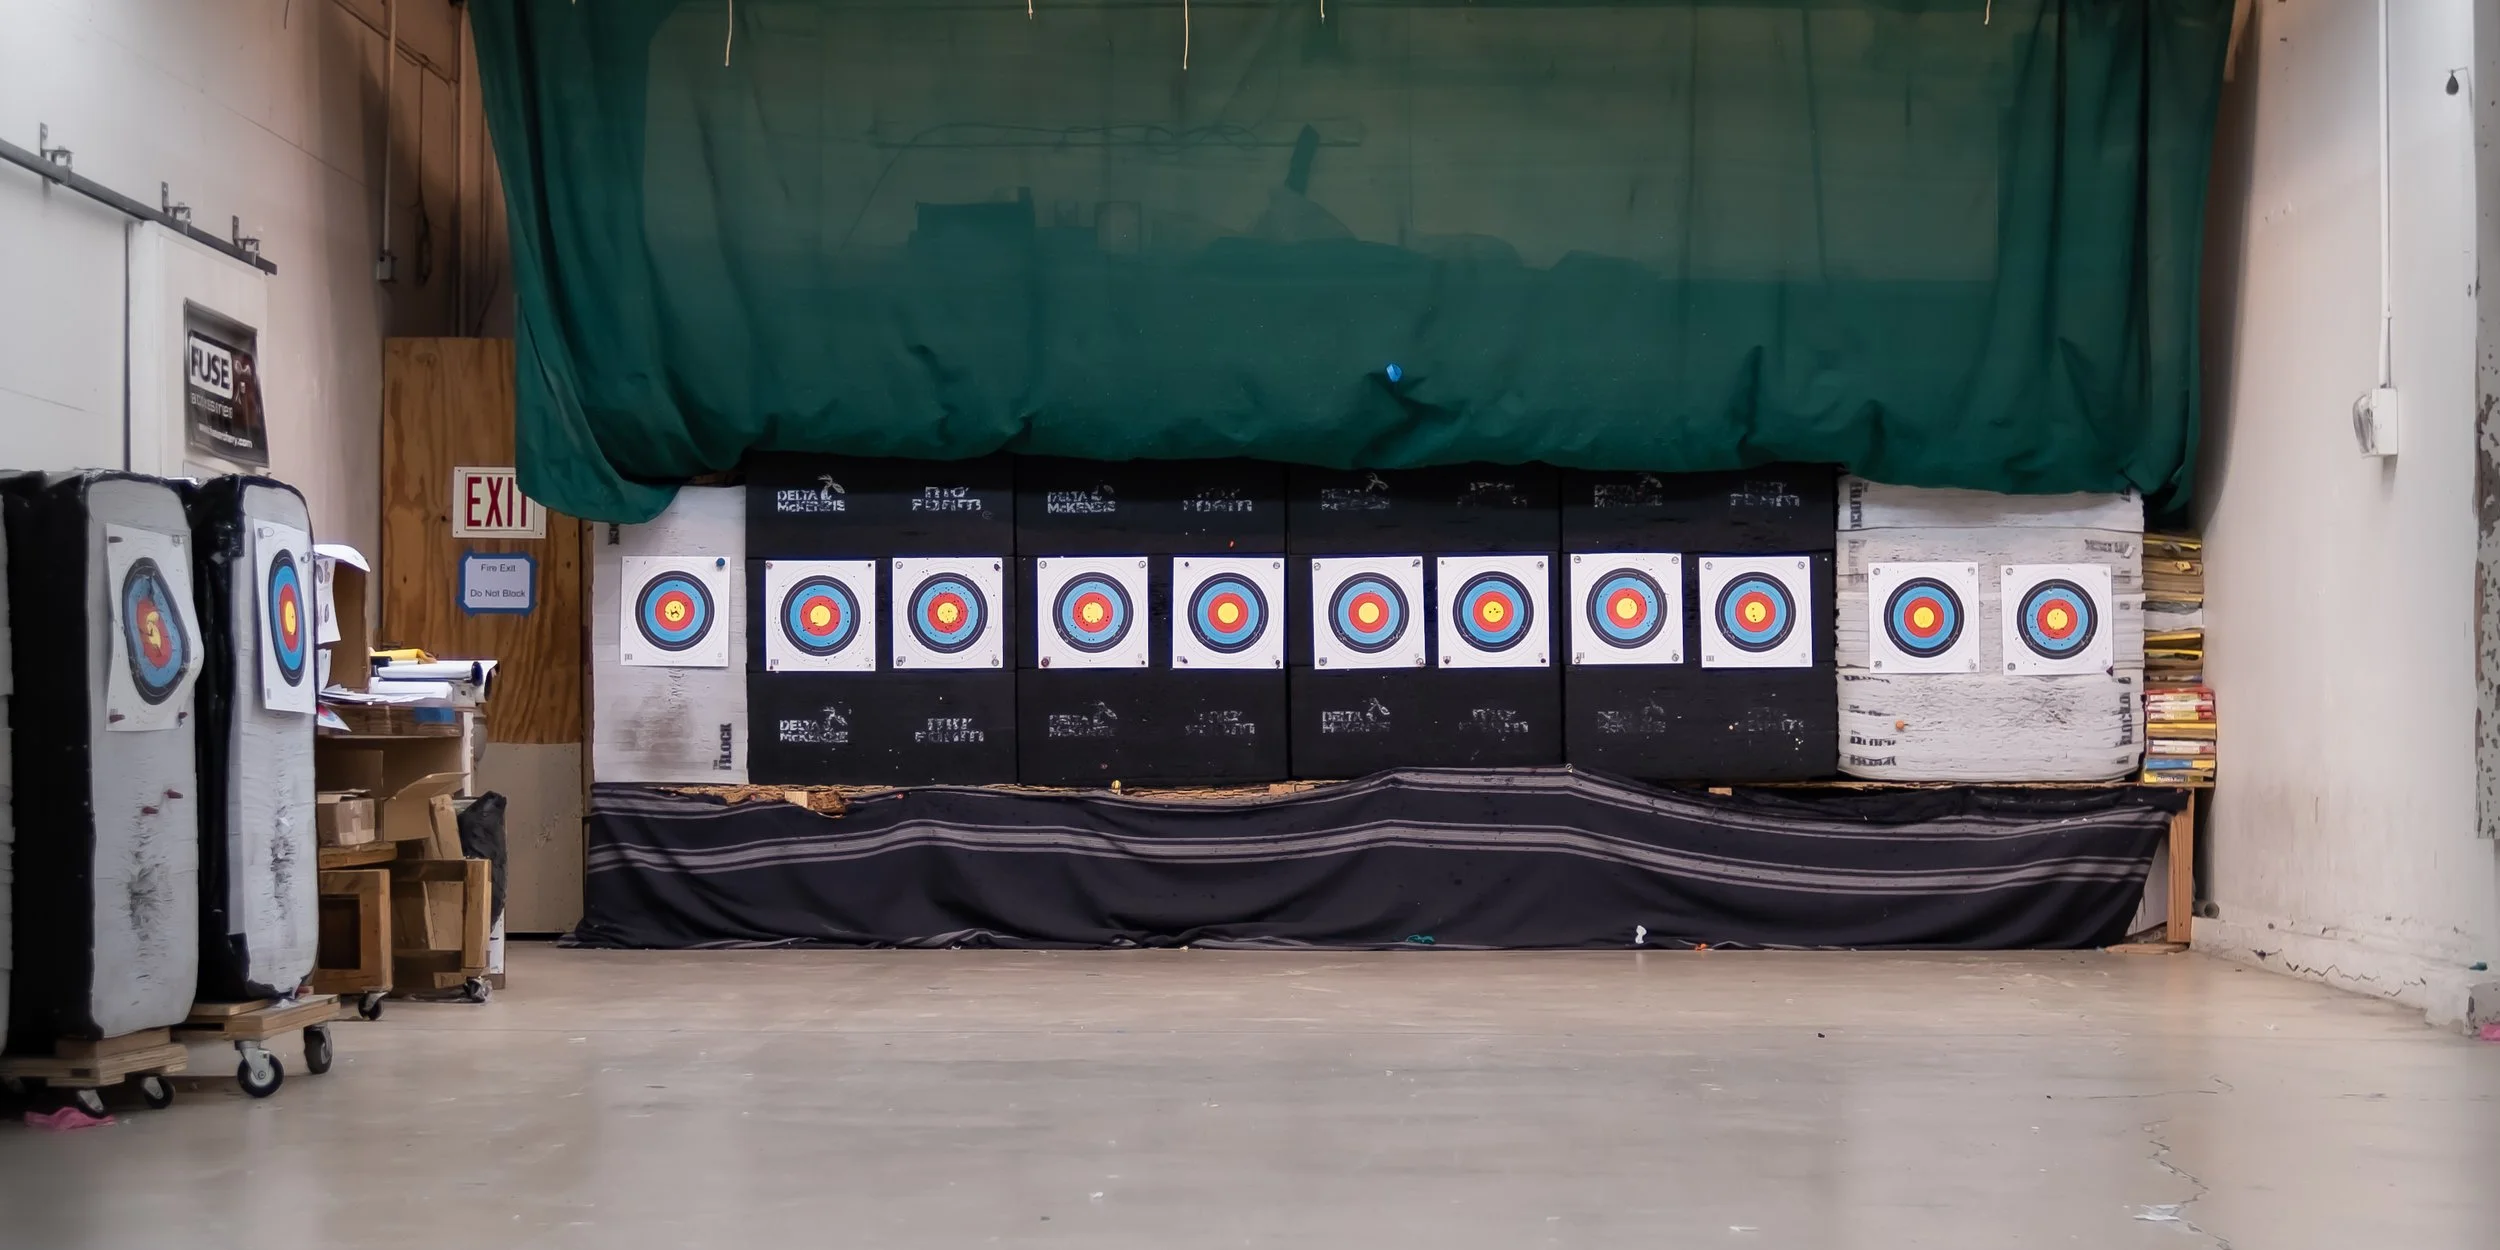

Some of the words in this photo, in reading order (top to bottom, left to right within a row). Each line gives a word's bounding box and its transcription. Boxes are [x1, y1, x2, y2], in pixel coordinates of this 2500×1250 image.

[191, 345, 231, 390] FUSE
[777, 490, 818, 501] DELTA
[777, 500, 846, 512] McKENZIE
[480, 563, 497, 572] Fire
[500, 563, 516, 572] Exit
[470, 589, 482, 597] Do
[485, 589, 500, 597] Not
[502, 588, 526, 598] Block
